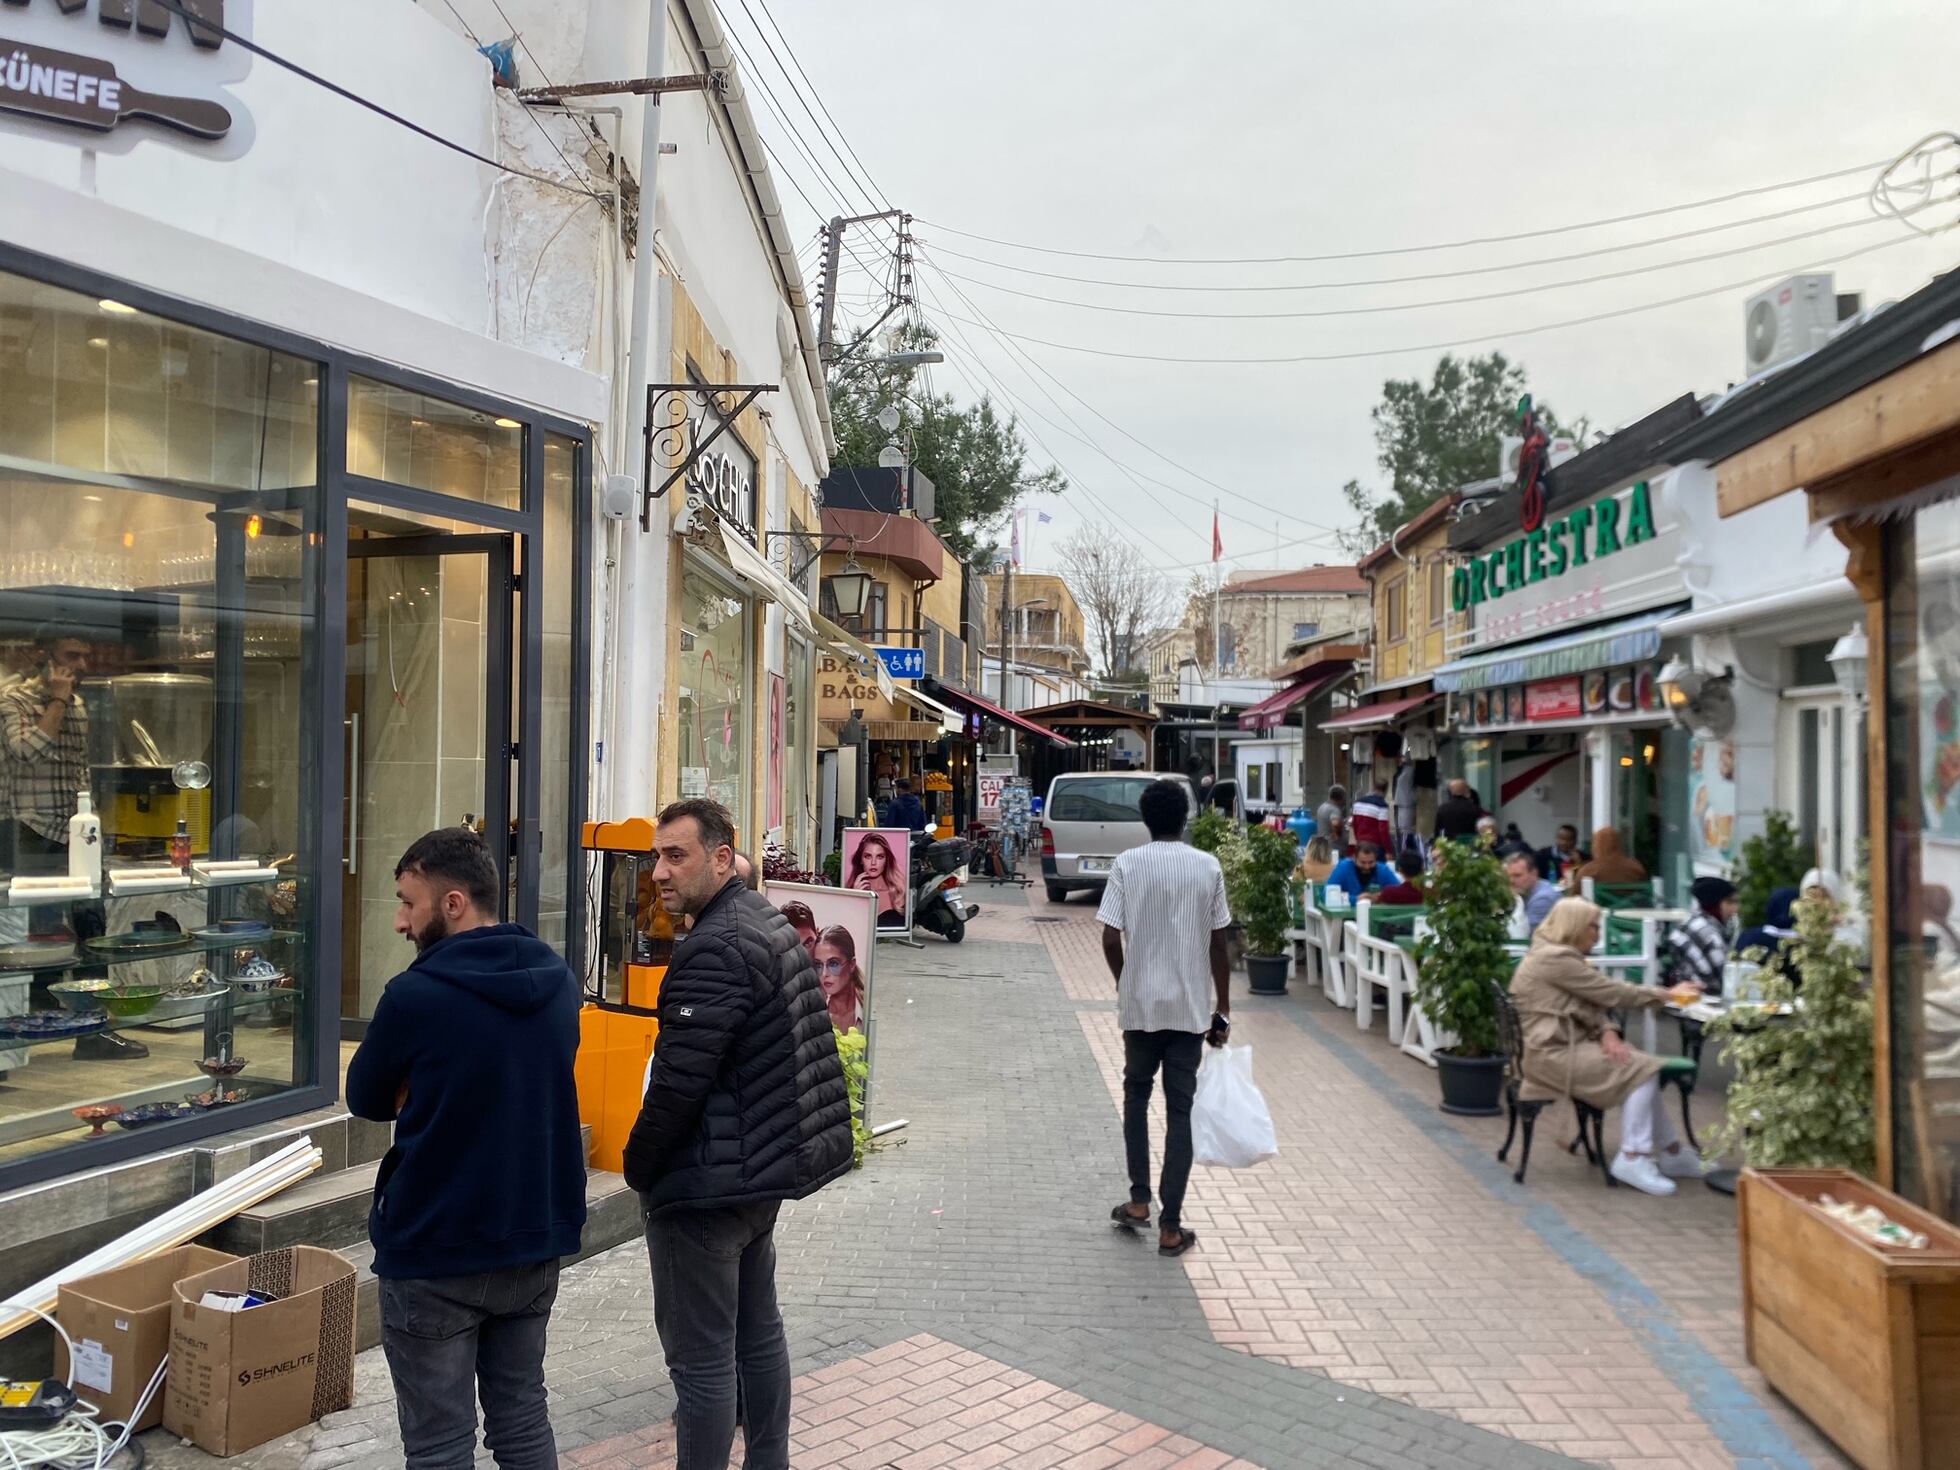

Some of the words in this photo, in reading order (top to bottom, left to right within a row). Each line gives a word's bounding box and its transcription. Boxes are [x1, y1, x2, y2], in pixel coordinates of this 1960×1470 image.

[719, 451, 751, 532] CHIC
[1452, 480, 1657, 612] ORCHESTRA
[822, 684, 878, 700] BAGS
[847, 674, 857, 684] &
[253, 1352, 315, 1380] SHNELITE
